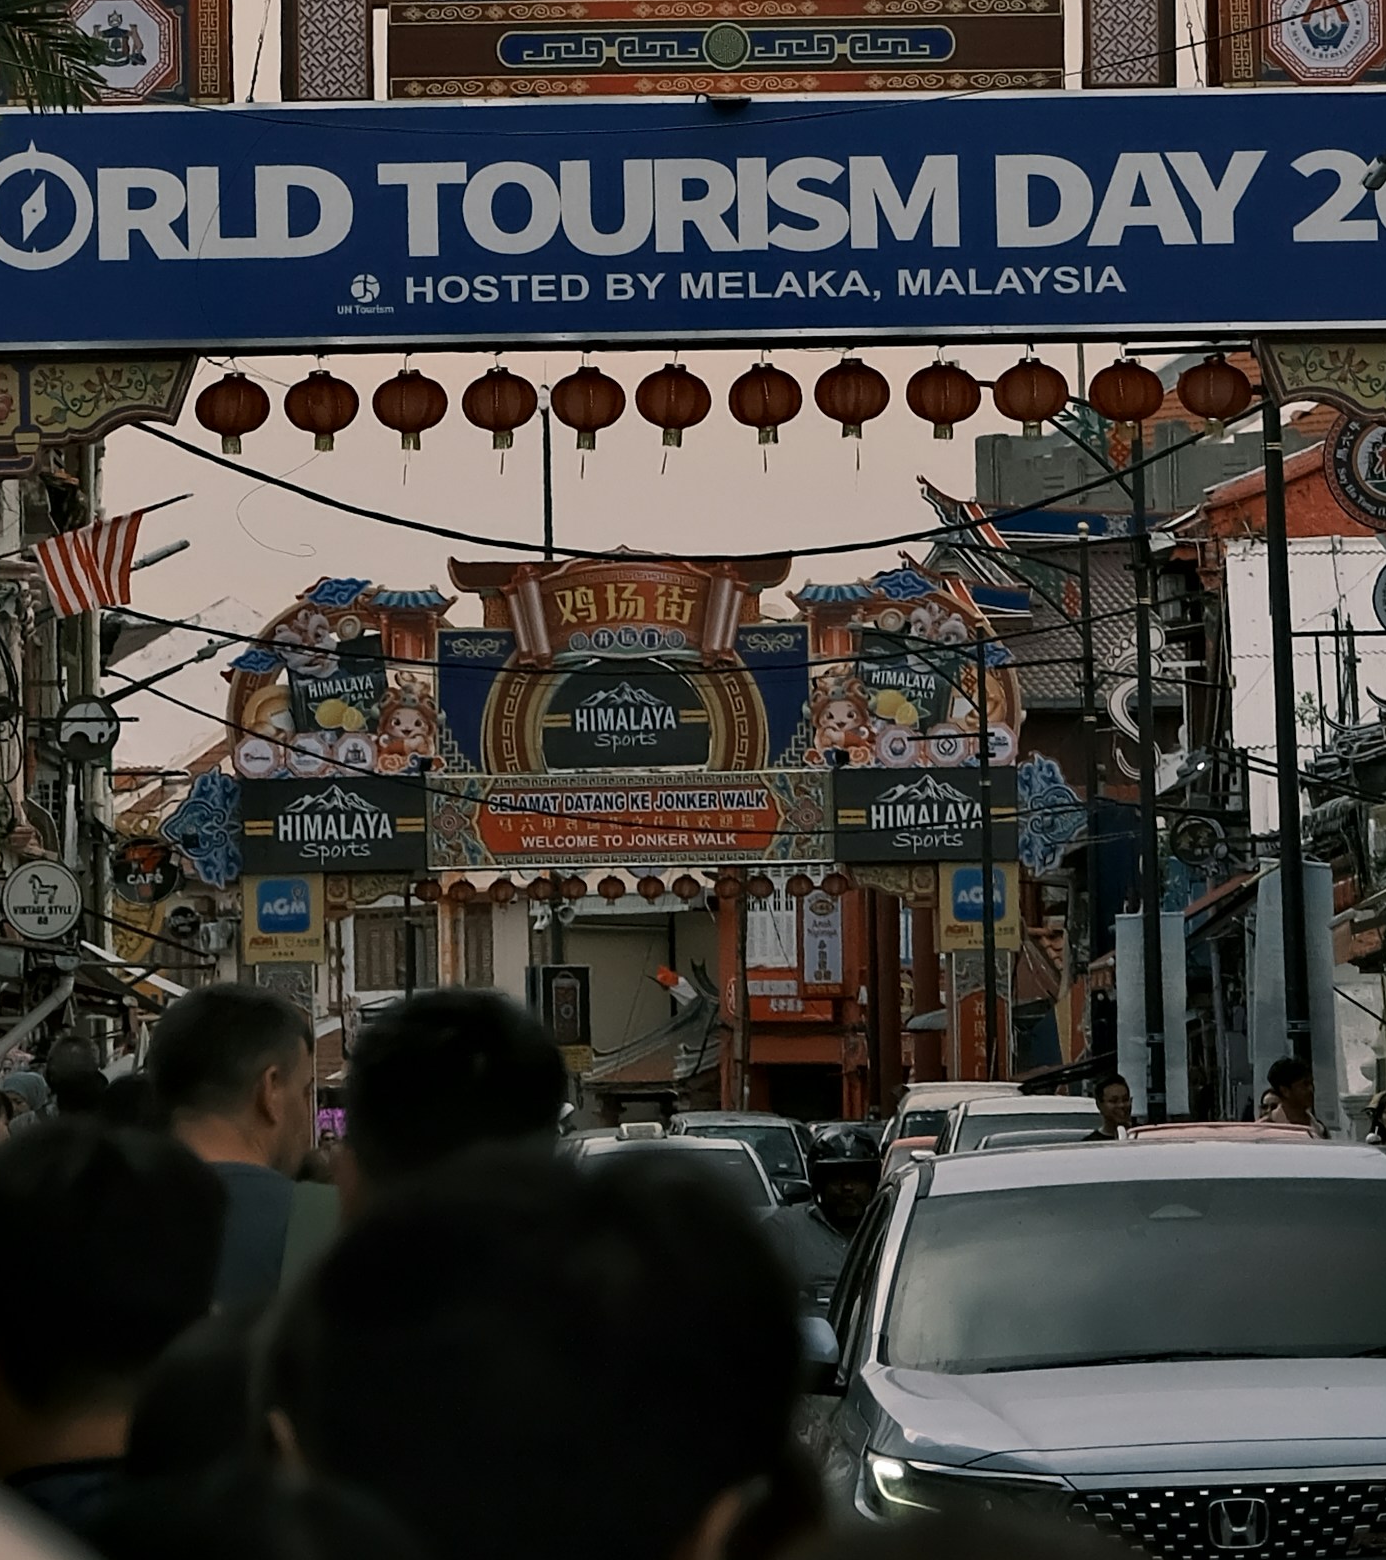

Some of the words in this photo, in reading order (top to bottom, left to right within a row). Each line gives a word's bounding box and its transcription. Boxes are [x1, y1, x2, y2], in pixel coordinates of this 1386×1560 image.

[377, 153, 960, 257] TOURISM
[996, 150, 1268, 248] DAY
[405, 273, 589, 306] HOSTED
[606, 272, 668, 302] BY
[680, 266, 882, 305] MELAKA,
[897, 261, 1128, 296] MALAYSIA
[337, 304, 353, 316] UN
[356, 304, 395, 316] Tourism
[555, 581, 701, 627] 鸡场街
[307, 679, 375, 700] HIMALAYA
[871, 669, 937, 692] HIMALAYA
[574, 707, 677, 732] HIMALAYA
[594, 731, 658, 753] Sports
[488, 794, 561, 815] SELAMAT
[564, 794, 626, 813] DATANG
[629, 794, 651, 812] KE
[653, 792, 718, 811] JONKER
[721, 790, 769, 809] WALK
[278, 811, 394, 843] HIMALAYA
[870, 801, 984, 830] HIMALAYA
[302, 840, 373, 865] Sports
[520, 833, 599, 850] WELCOME
[602, 833, 623, 848] TO
[626, 832, 689, 848] JONKER
[692, 831, 737, 847] WALK
[892, 831, 964, 855] Sports
[126, 867, 162, 885] CAFÉ
[13, 906, 47, 916] VINTAGE
[48, 906, 72, 915] STYLE
[262, 897, 307, 916] AGM
